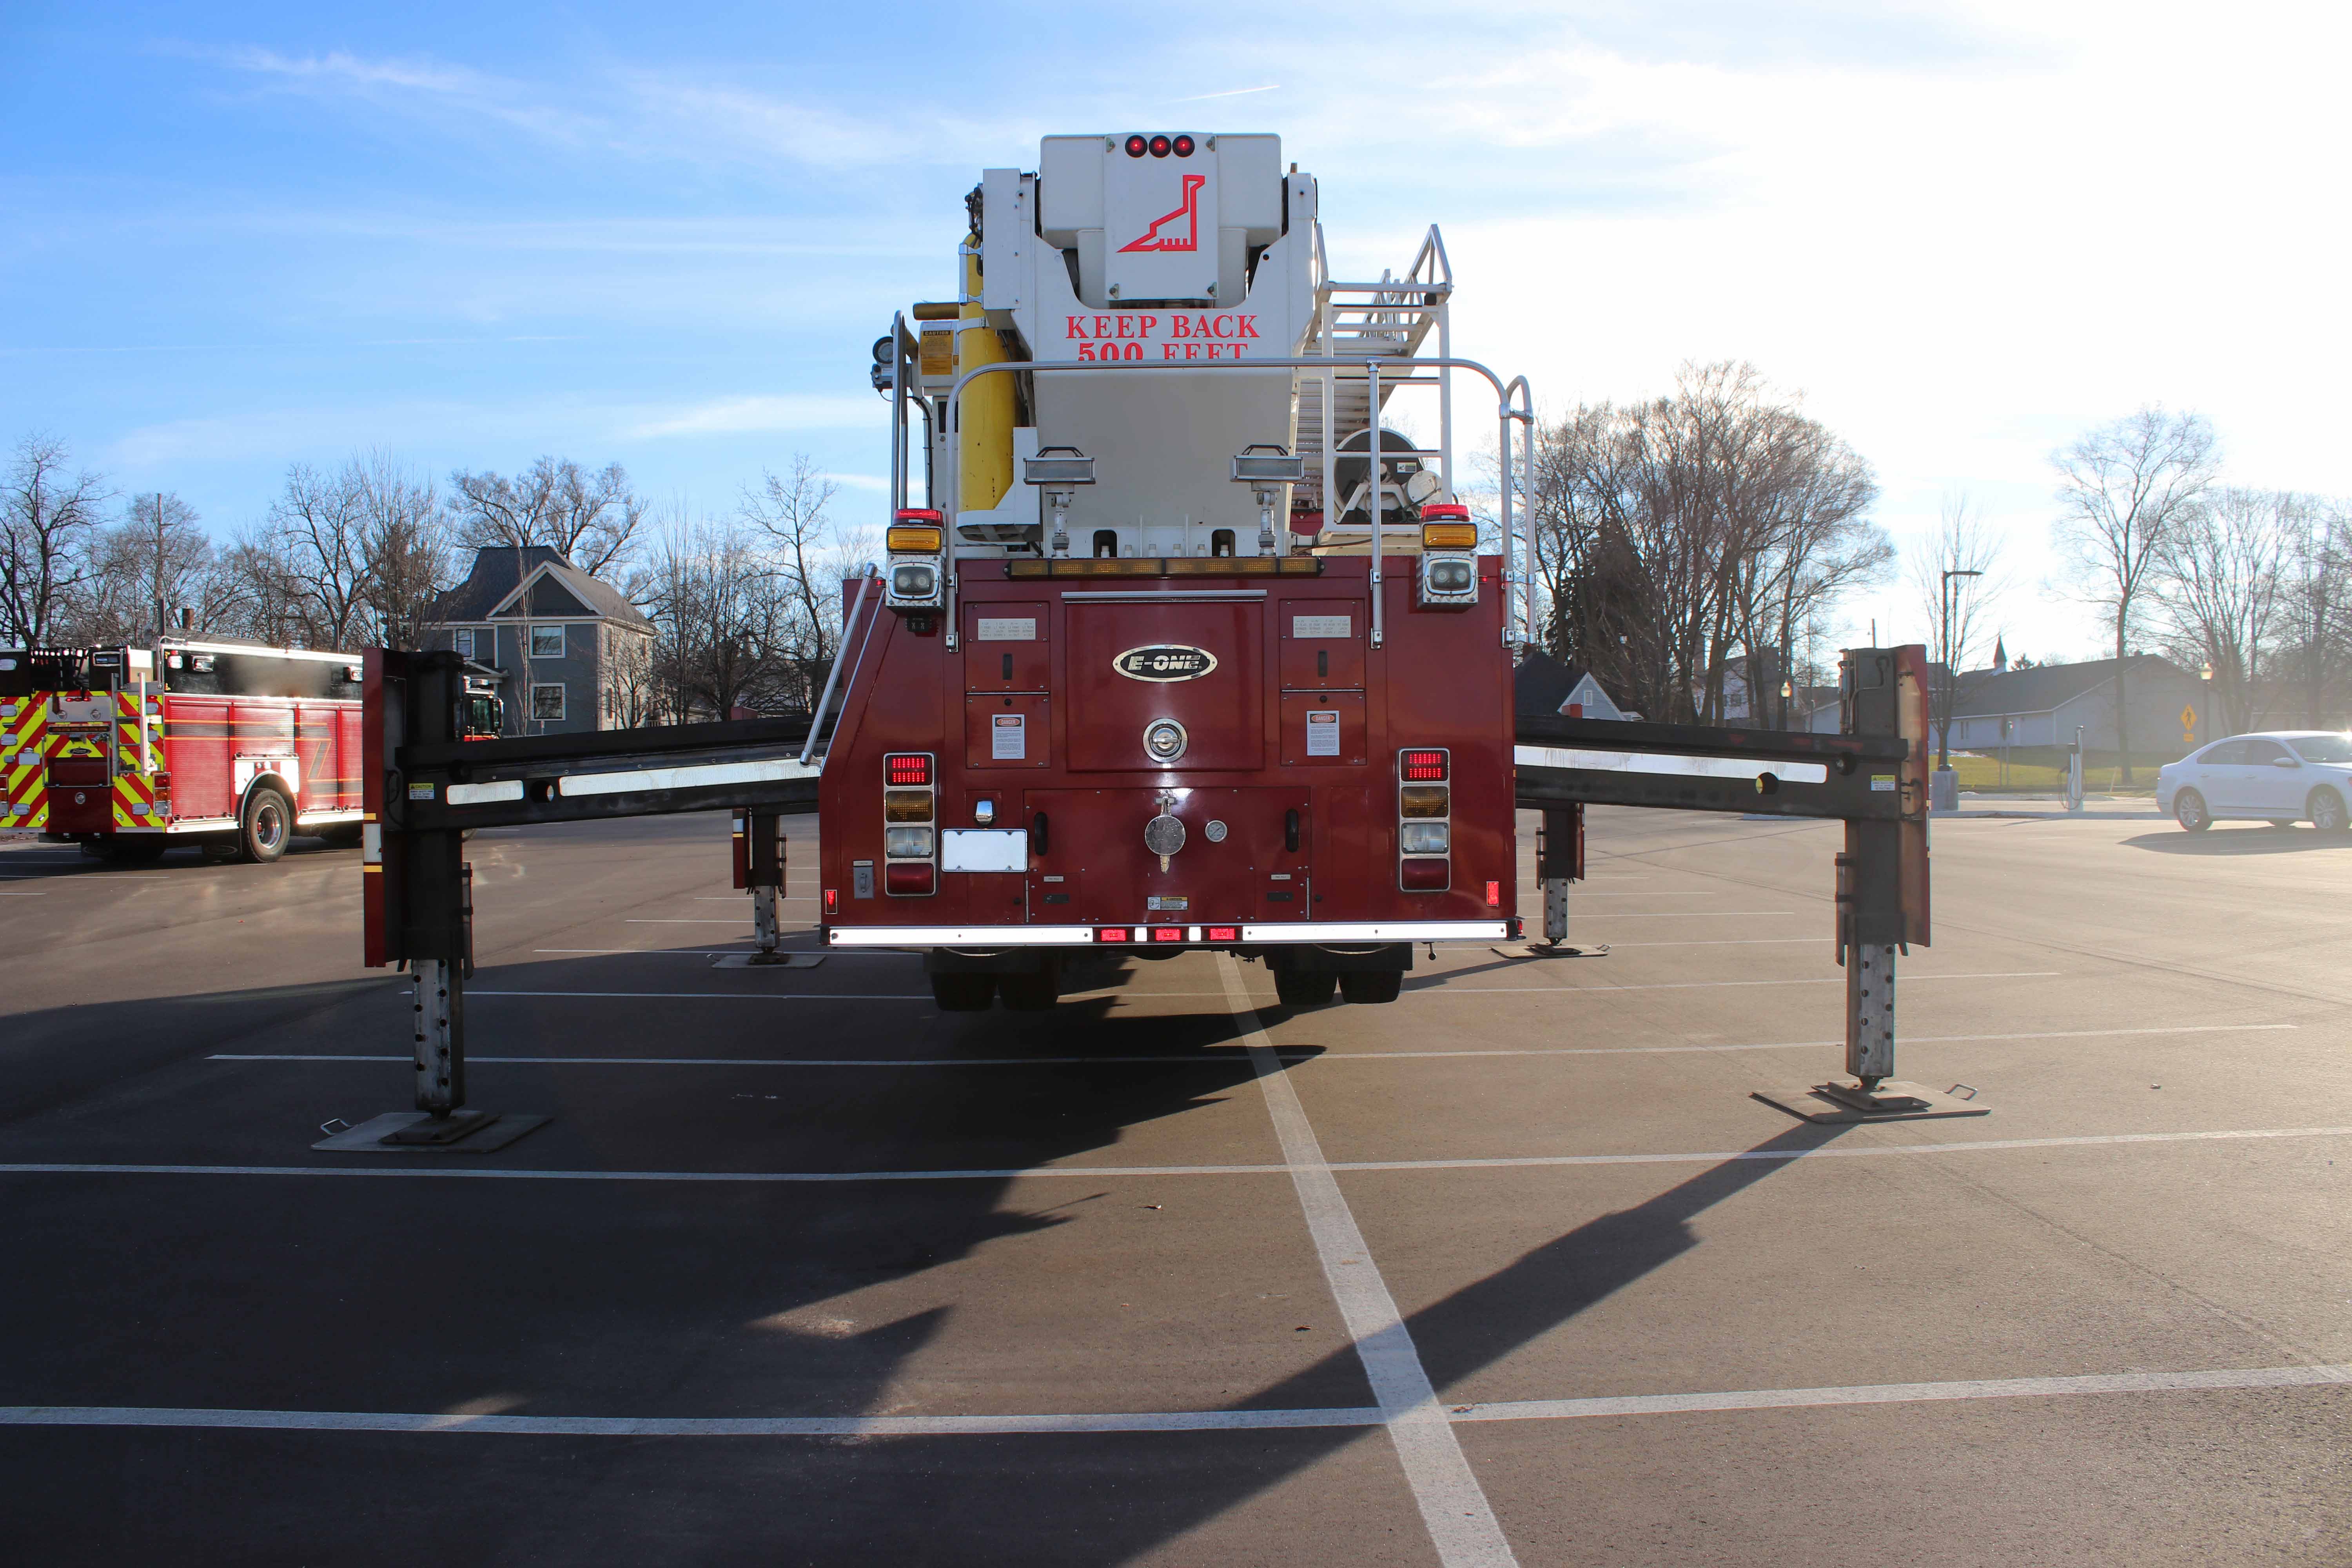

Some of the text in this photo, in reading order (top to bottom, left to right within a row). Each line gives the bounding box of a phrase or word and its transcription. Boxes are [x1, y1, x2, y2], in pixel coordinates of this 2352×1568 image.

[1065, 315, 1260, 339] KEEP BACK
[1078, 342, 1143, 361] 500
[1128, 655, 1201, 671] E-ONE
